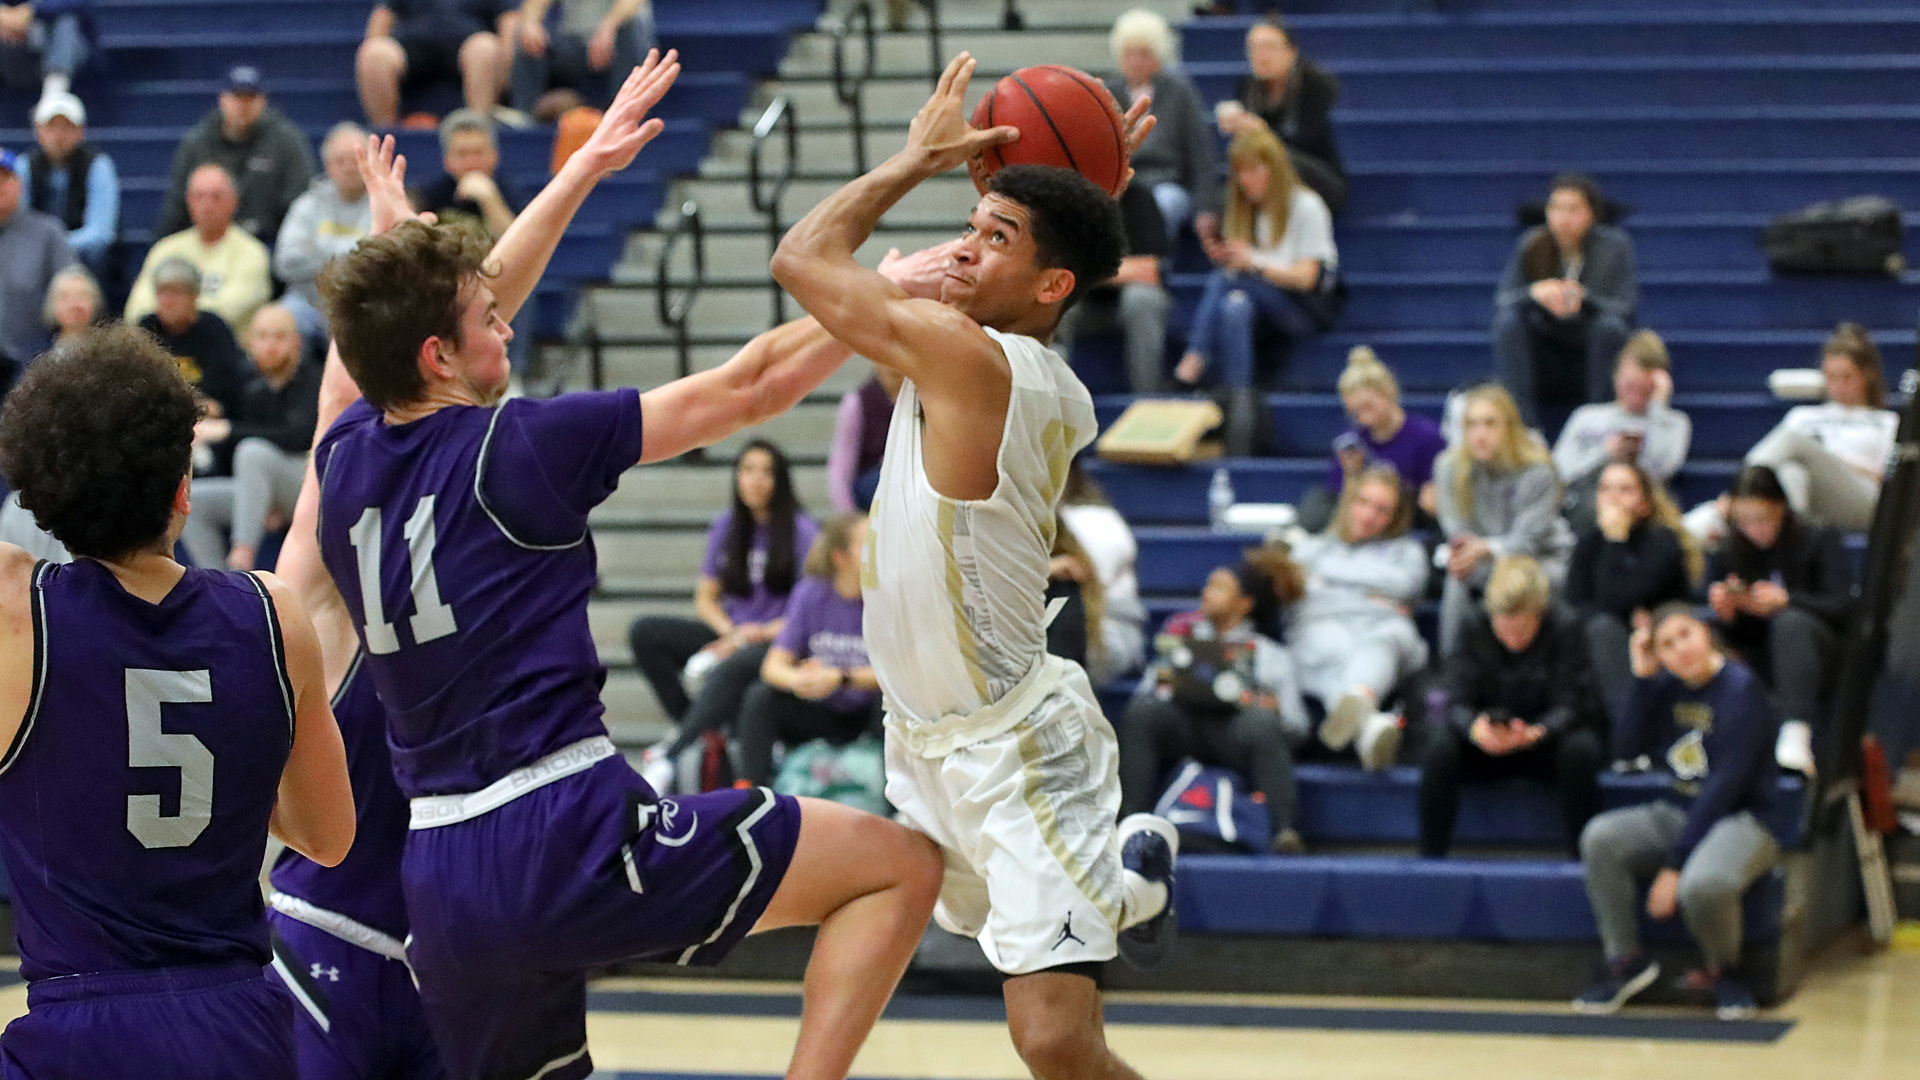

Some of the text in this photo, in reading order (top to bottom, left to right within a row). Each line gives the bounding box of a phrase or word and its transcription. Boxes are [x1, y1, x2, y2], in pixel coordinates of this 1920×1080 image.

[349, 494, 457, 654] 11
[125, 668, 214, 849] 5
[509, 740, 609, 789] RMOUR
